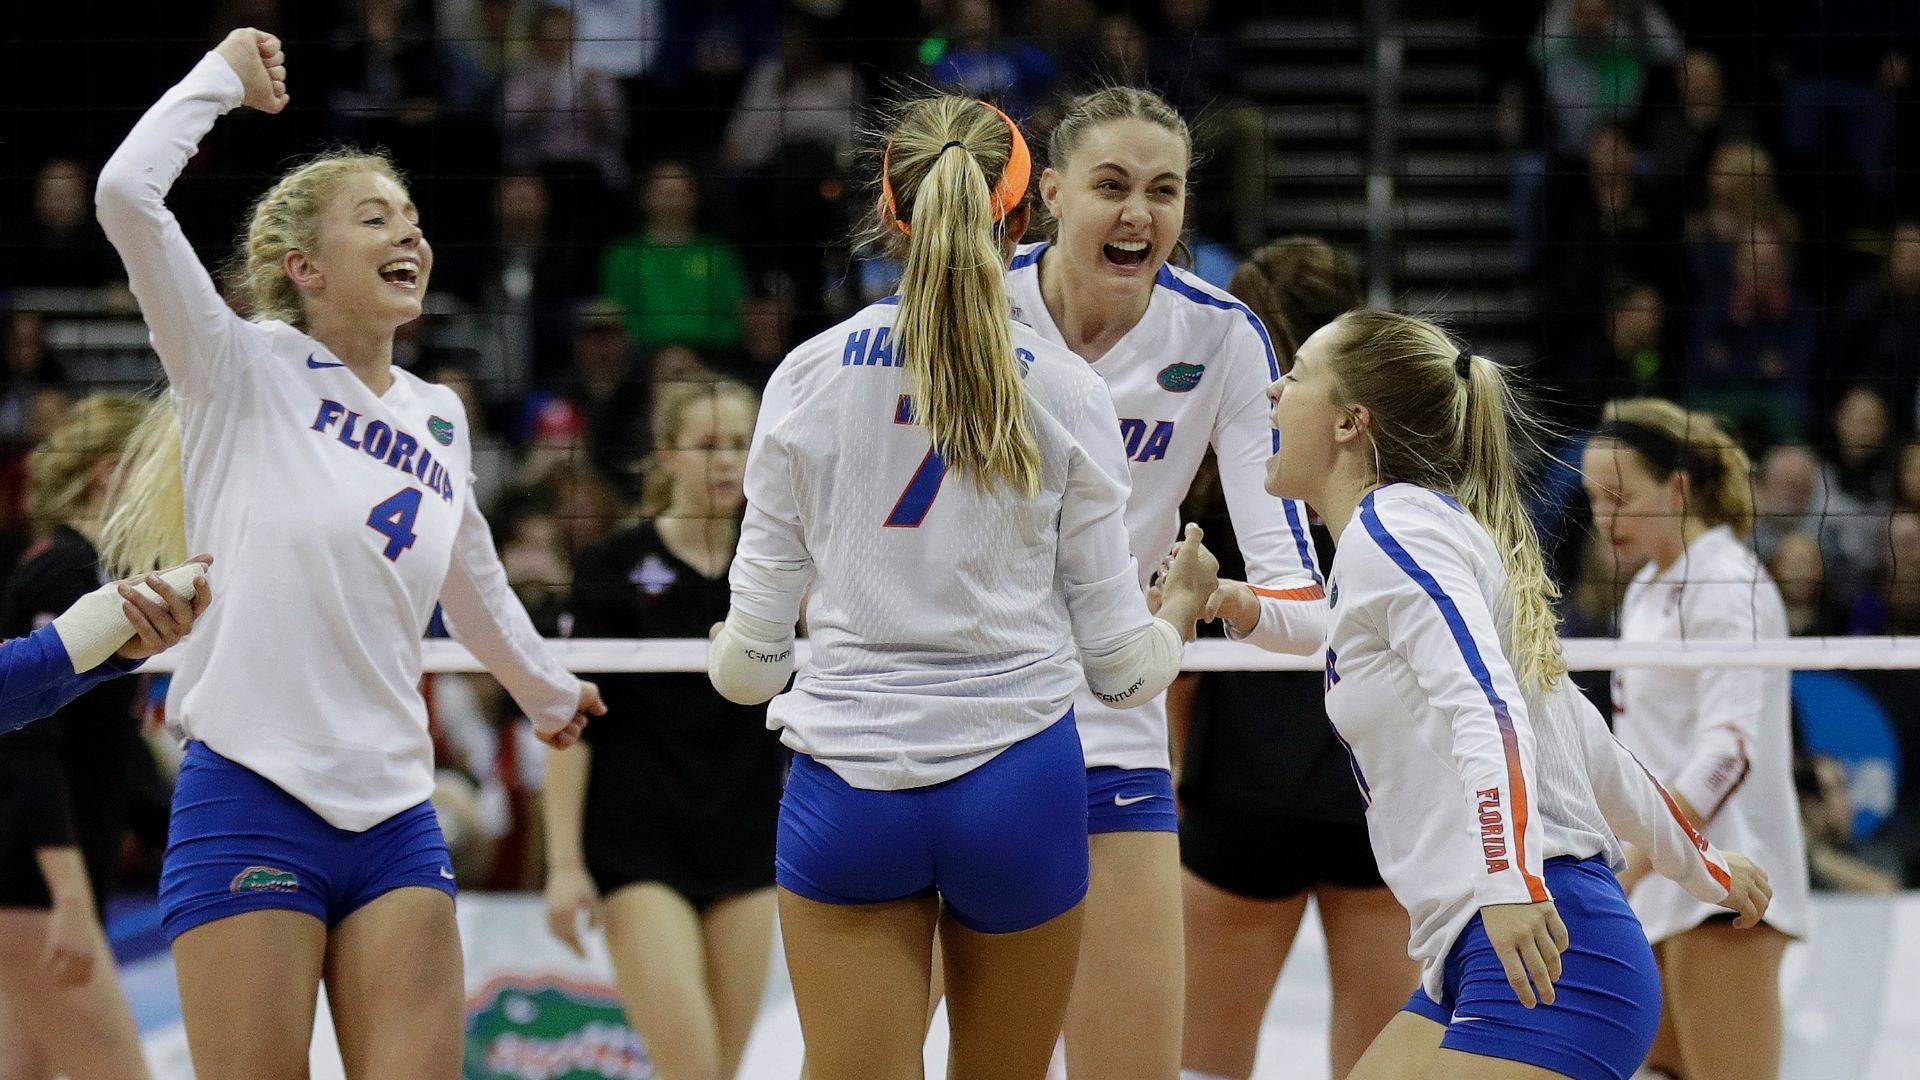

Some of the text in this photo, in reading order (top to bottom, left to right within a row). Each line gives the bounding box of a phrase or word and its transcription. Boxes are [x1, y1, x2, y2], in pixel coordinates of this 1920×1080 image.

[309, 399, 453, 503] FLORIDA
[366, 486, 423, 562] 4
[1476, 787, 1509, 874] FLORIDA
